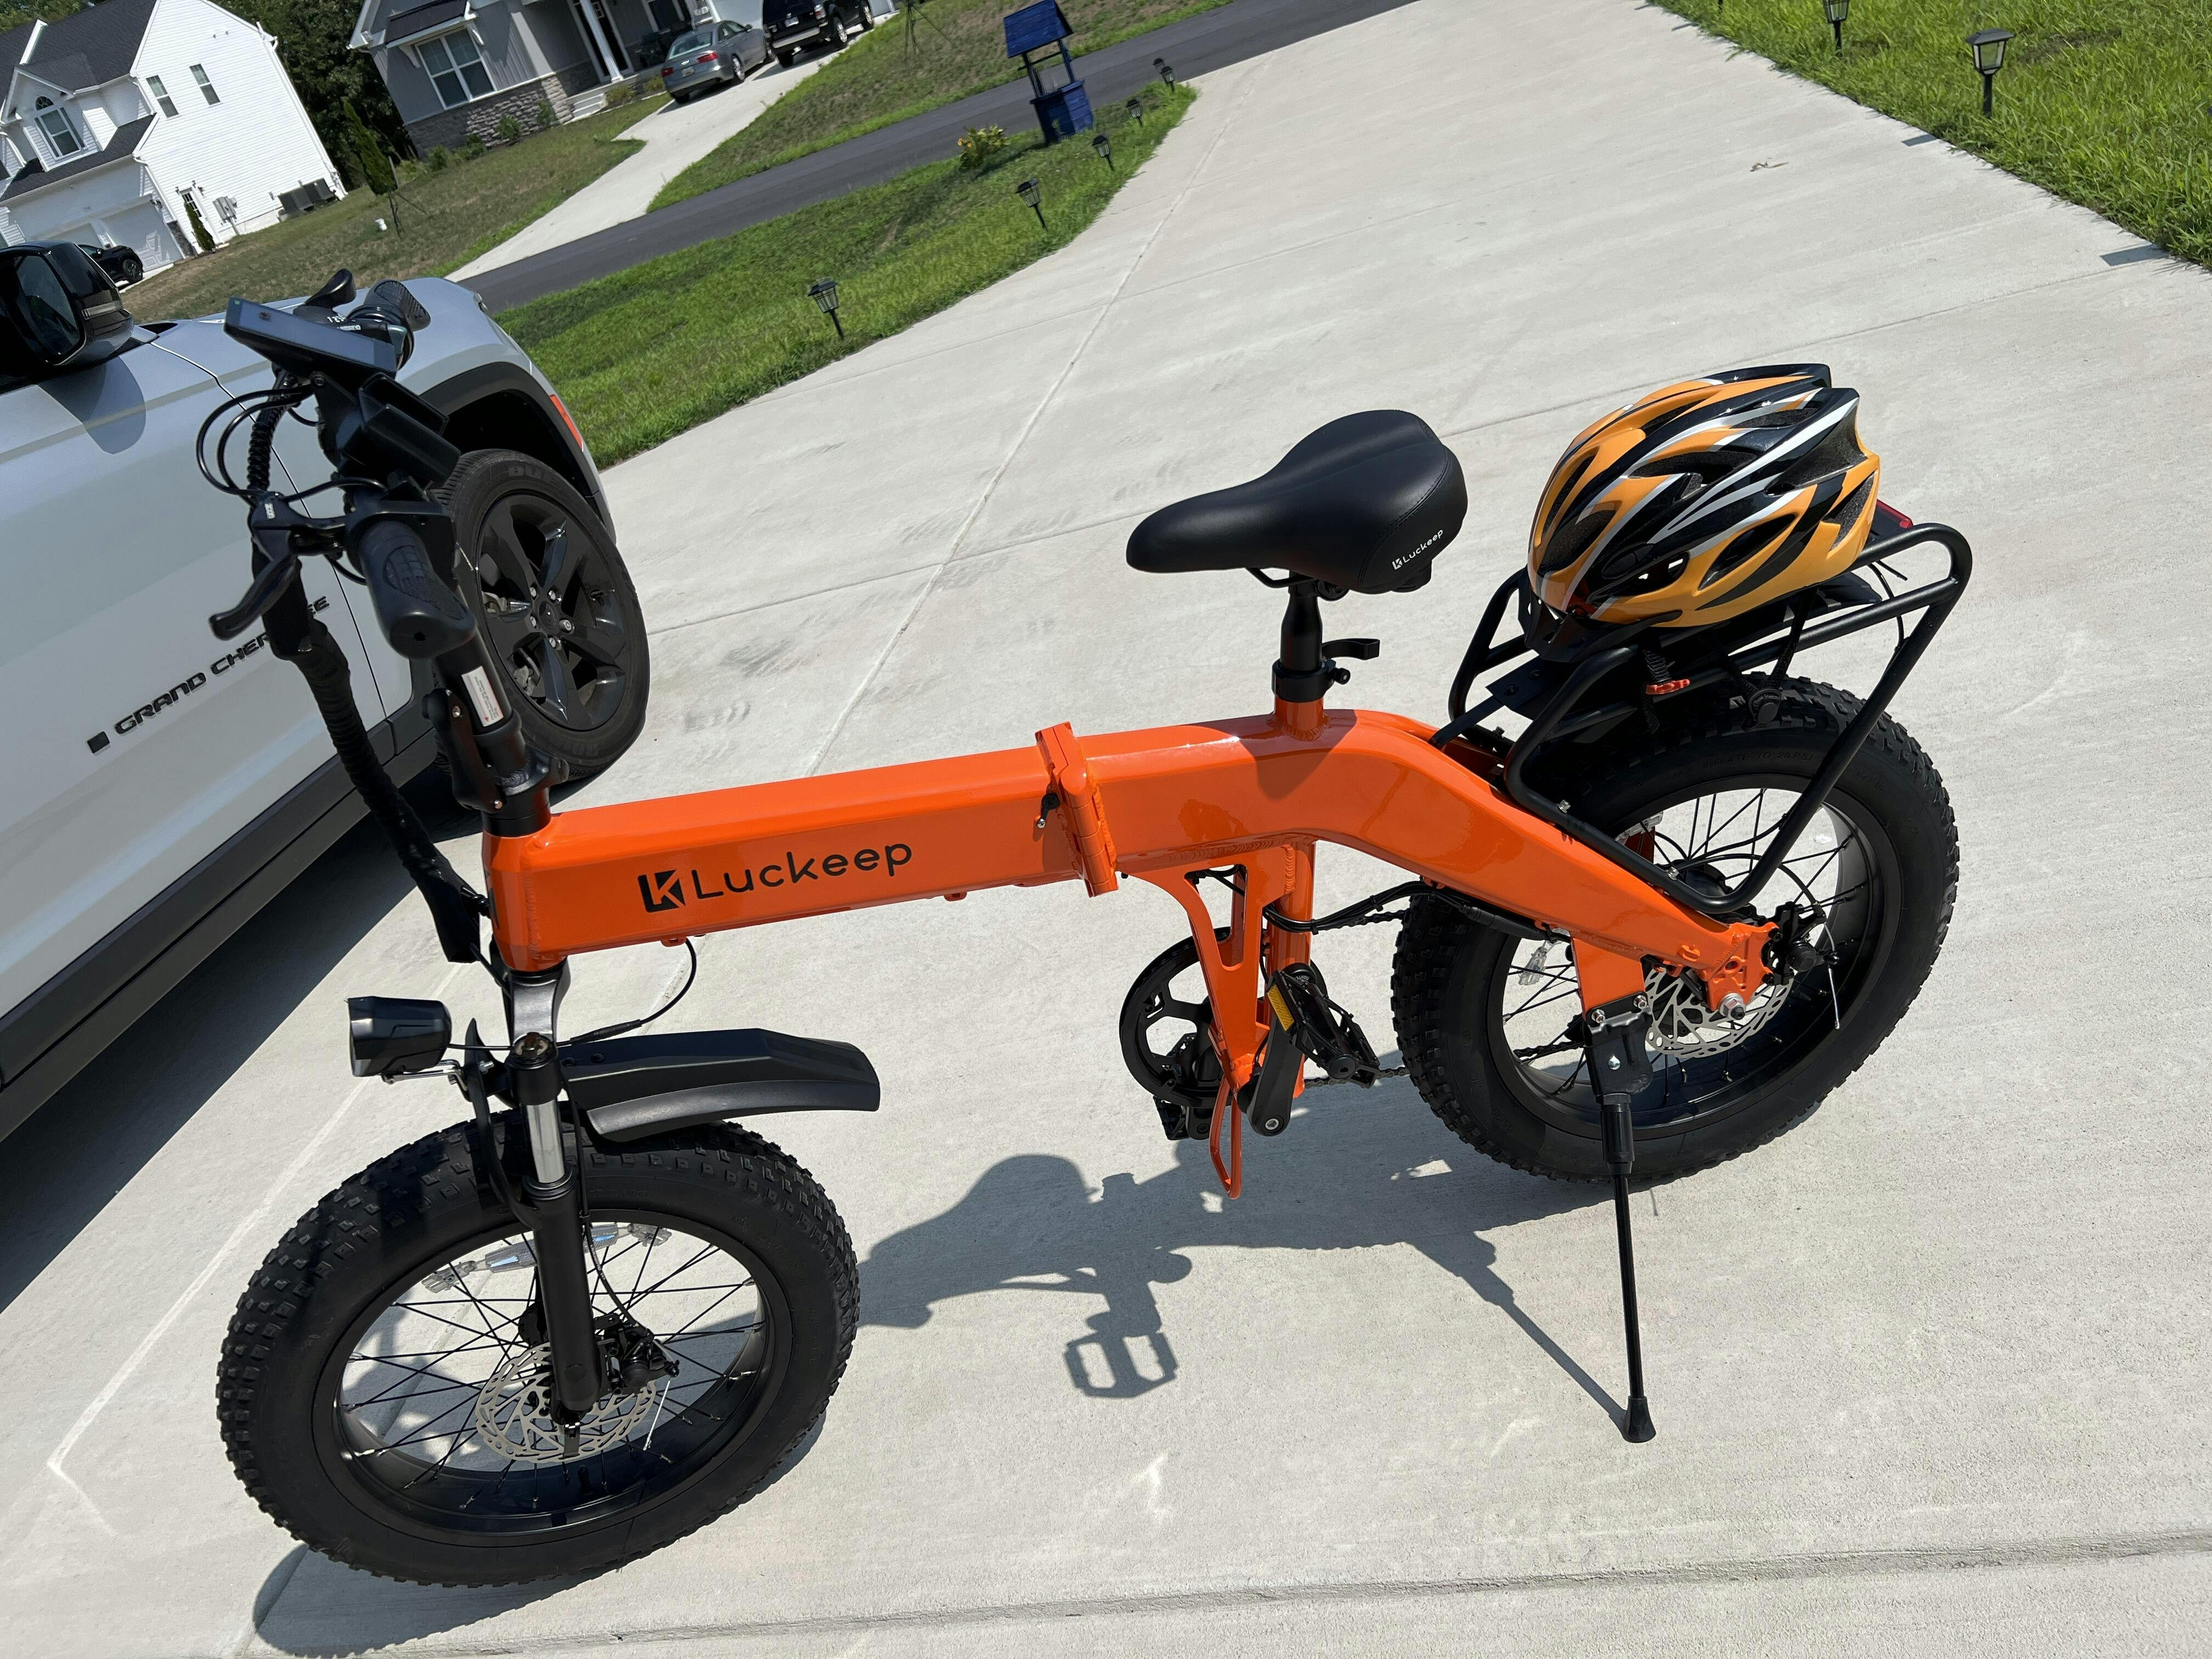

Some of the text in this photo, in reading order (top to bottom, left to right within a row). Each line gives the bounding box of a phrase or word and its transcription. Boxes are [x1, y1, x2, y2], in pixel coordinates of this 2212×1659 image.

[1402, 529, 1444, 563] Luckeep
[114, 672, 207, 735] GRAND
[691, 842, 913, 900] Luckeep
